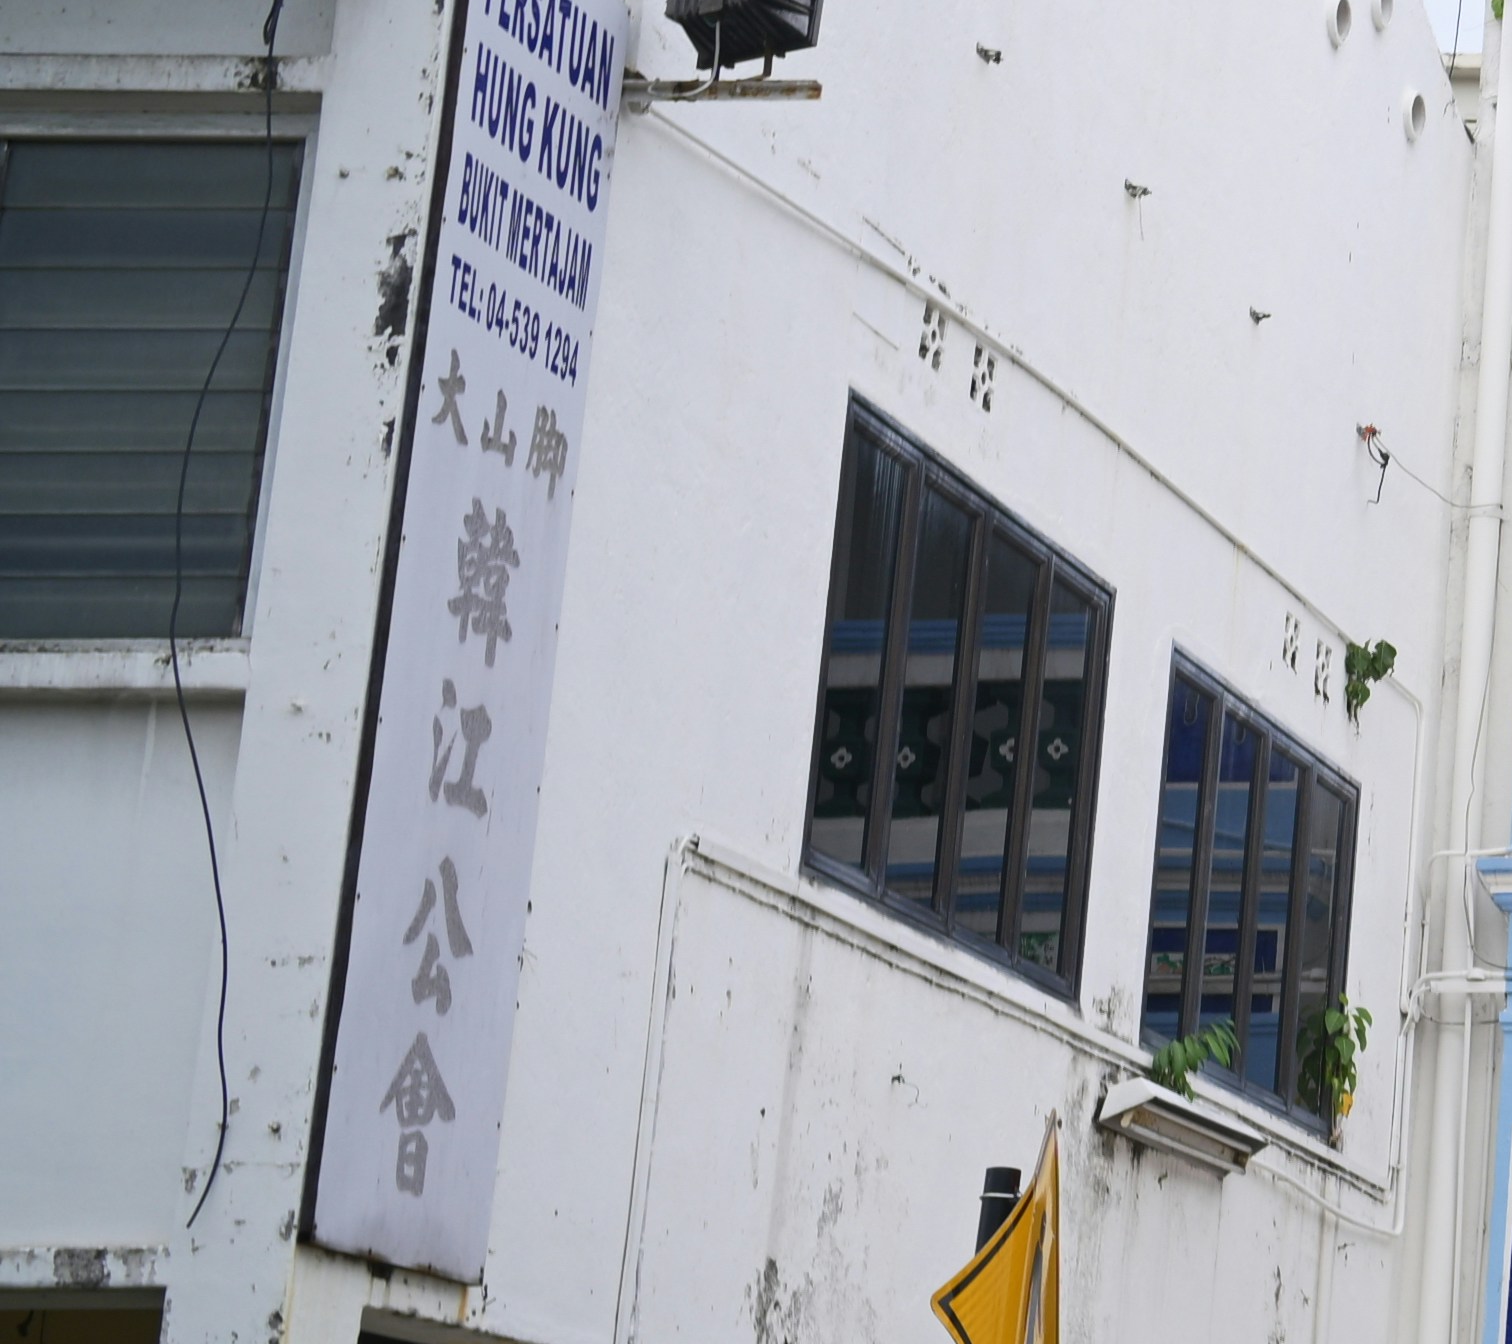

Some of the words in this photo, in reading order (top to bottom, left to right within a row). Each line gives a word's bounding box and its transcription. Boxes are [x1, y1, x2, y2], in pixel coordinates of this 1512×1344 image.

[470, 42, 537, 163] HUNG
[538, 96, 603, 213] KUNG
[457, 151, 509, 252] BUKIT
[506, 189, 593, 312] MERTAJAM
[450, 254, 485, 324] TEL:
[486, 282, 540, 360] 04-539
[544, 320, 580, 388] 1294
[378, 496, 521, 1197] 韓江公會
